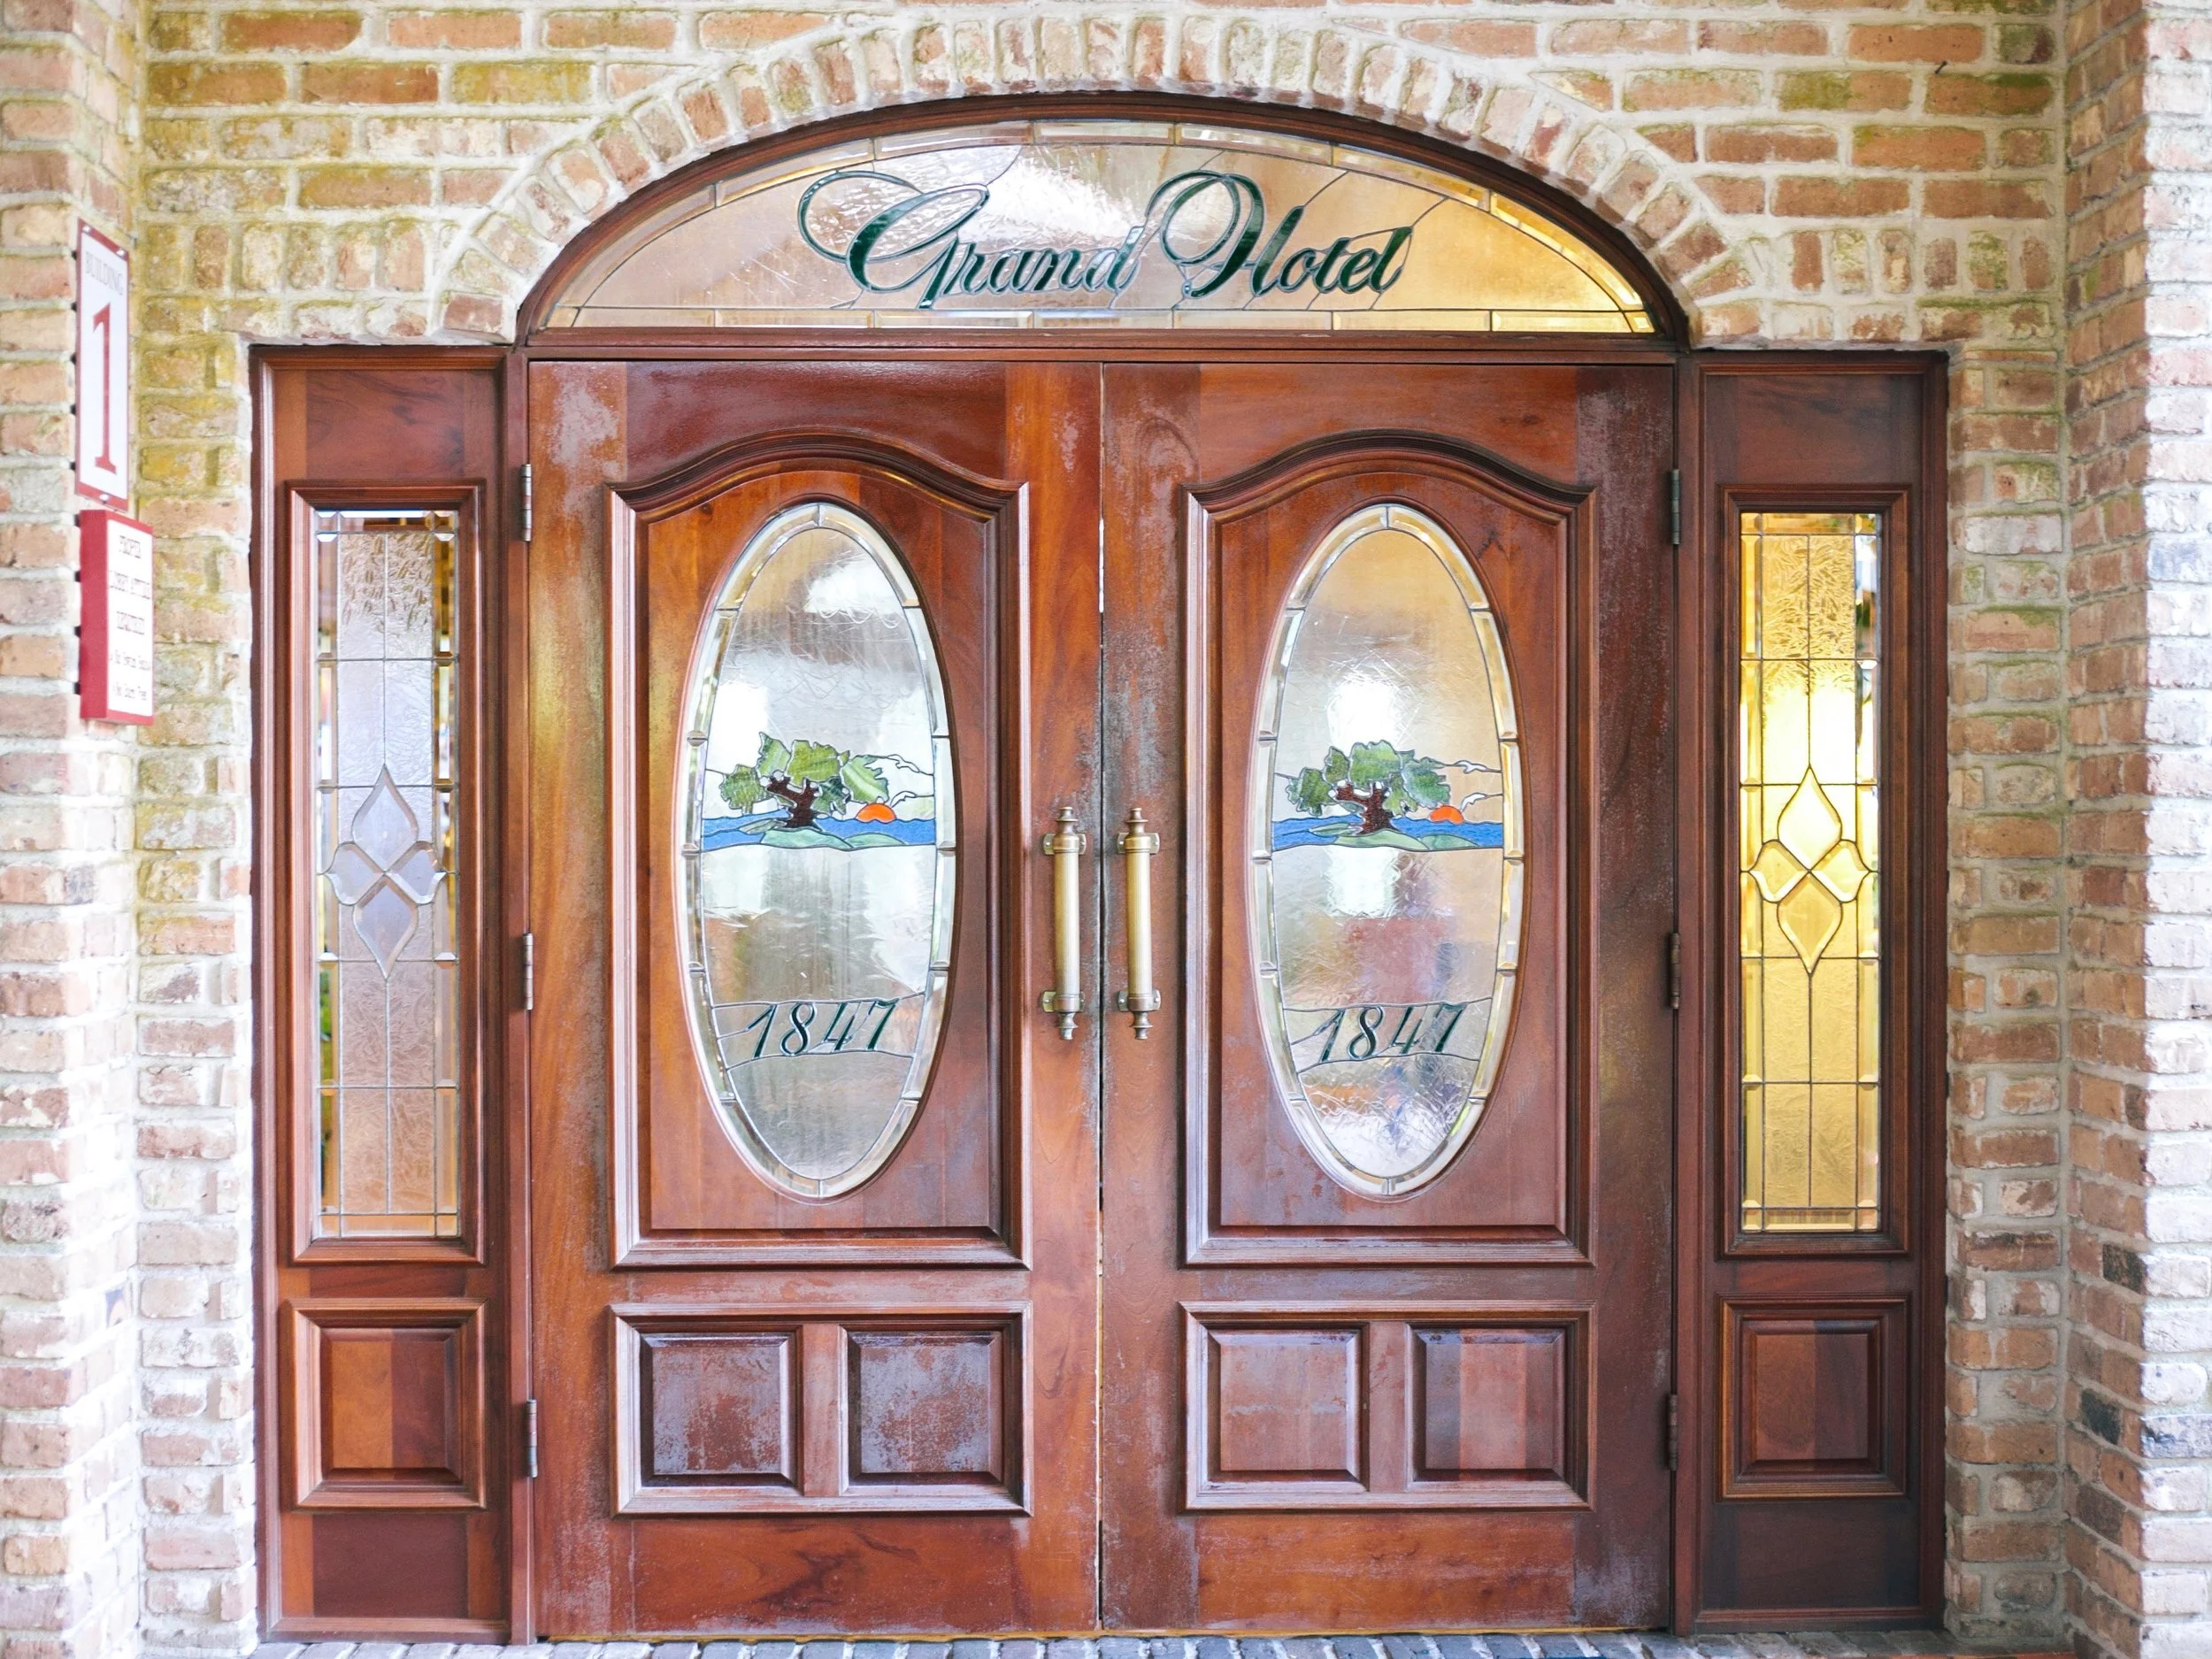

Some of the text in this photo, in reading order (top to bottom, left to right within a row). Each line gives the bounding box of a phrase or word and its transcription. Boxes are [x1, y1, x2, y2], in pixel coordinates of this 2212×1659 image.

[797, 169, 1413, 310] Grand Hotel
[85, 250, 125, 296] BUILDING
[92, 302, 117, 475] 1
[747, 997, 900, 1058] 1847
[1313, 1002, 1469, 1062] 1847
